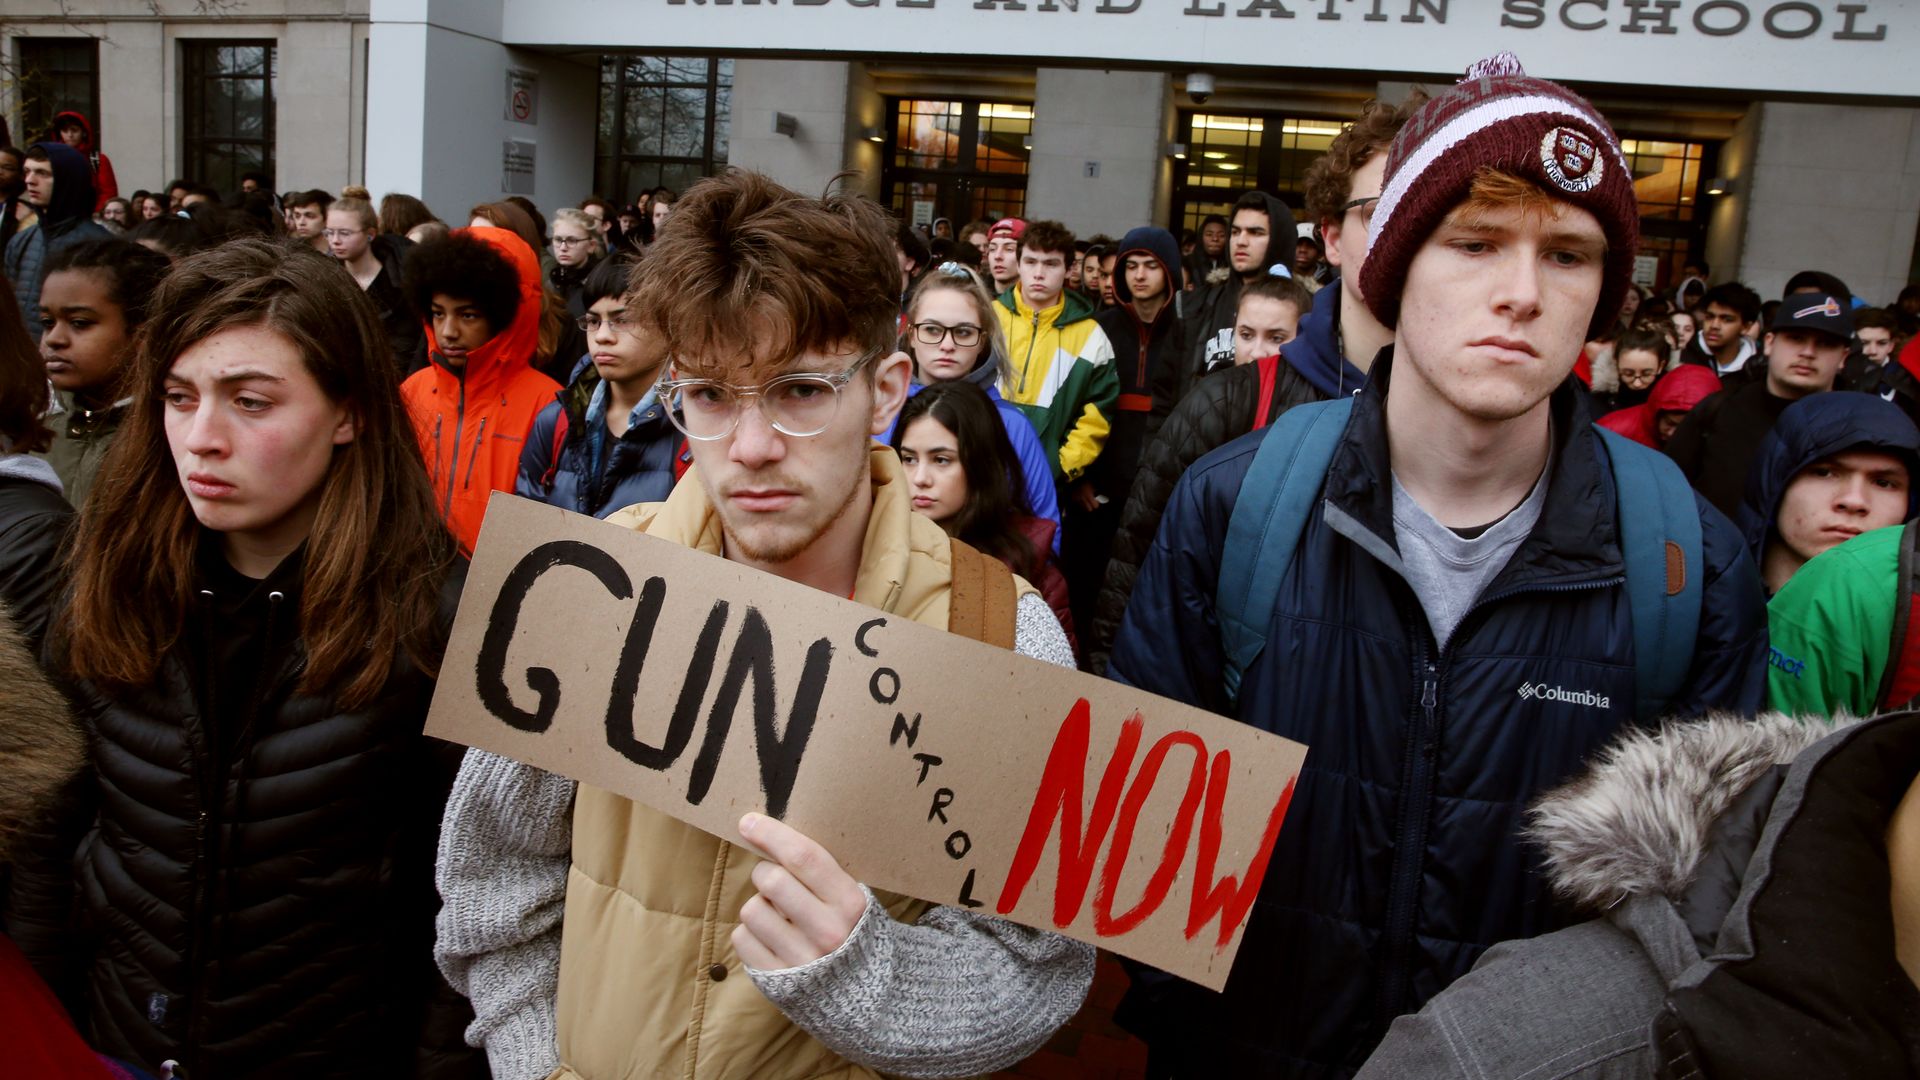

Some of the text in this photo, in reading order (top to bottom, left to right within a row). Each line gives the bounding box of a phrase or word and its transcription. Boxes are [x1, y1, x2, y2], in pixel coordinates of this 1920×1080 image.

[1500, 0, 1887, 41] SCHOOL
[1548, 169, 1583, 191] HARVARD
[1534, 683, 1611, 709] Columbia
[475, 539, 1297, 956] GUN CONTROL NOW
